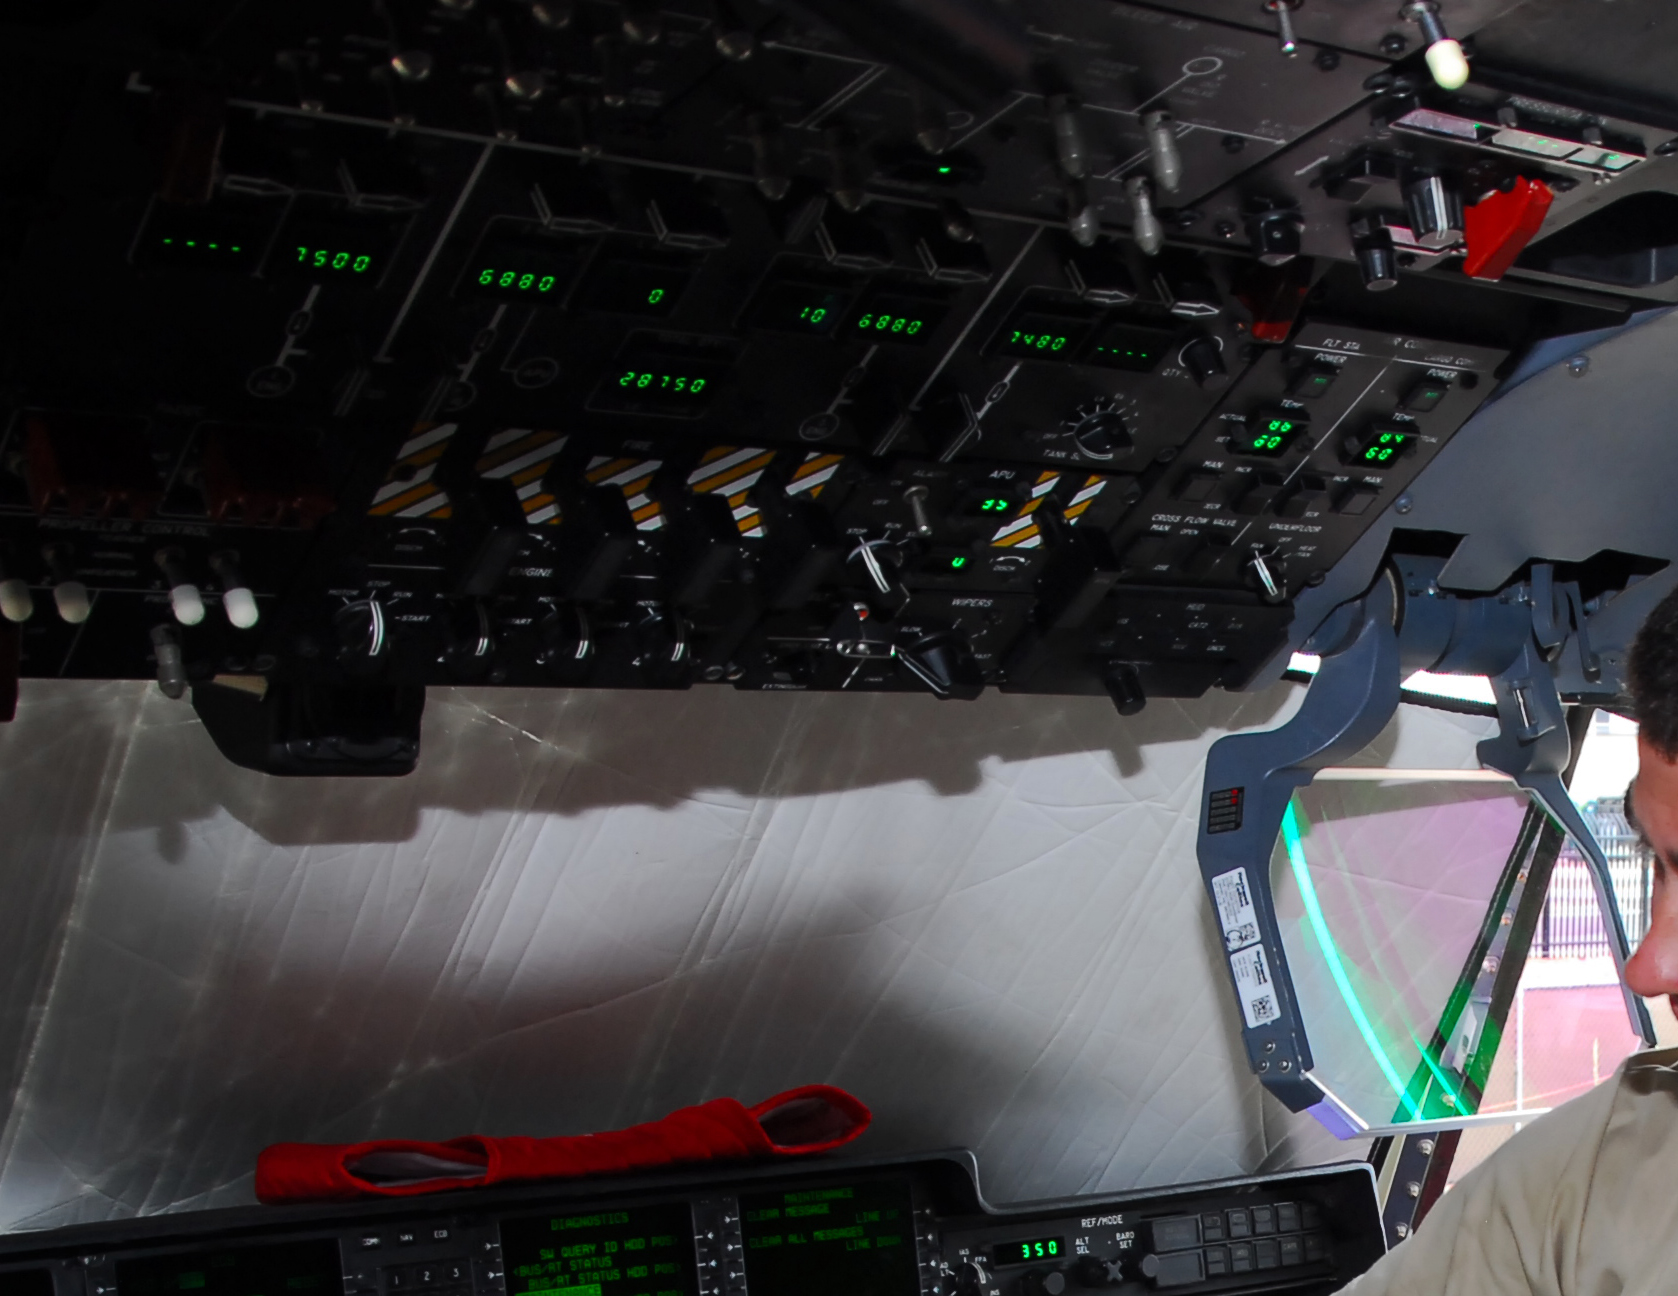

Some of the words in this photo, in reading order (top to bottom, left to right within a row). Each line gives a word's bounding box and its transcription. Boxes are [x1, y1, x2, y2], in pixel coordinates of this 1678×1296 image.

[296, 245, 371, 273] 7500
[478, 268, 557, 293] 6880
[648, 287, 665, 305] 0
[800, 306, 827, 324] 10
[858, 313, 923, 336] 6880
[1010, 331, 1067, 351] 7480
[1314, 352, 1347, 364] POWER
[1426, 368, 1458, 379] POWER
[619, 371, 706, 393] 28750
[1218, 413, 1247, 422] ACTUAL
[1253, 434, 1282, 449] 60
[1042, 449, 1068, 459] TANK
[1202, 460, 1224, 469] MAN
[988, 470, 1017, 480] APU
[1151, 513, 1182, 523] CROSS
[1183, 516, 1208, 525] FLOW
[1212, 518, 1238, 527] VALVE
[1149, 524, 1171, 532] MAN
[1268, 522, 1322, 533] UNDERFLOOR
[951, 598, 993, 607] WIPERS
[401, 614, 431, 622] START
[551, 1211, 629, 1231] DIAGNOSTICS
[1081, 1214, 1124, 1228] REF/MODE
[1075, 1237, 1090, 1245] ALT
[1115, 1231, 1135, 1241] BARO
[561, 1243, 597, 1258] QUERY
[1021, 1240, 1058, 1259] 350
[1076, 1246, 1090, 1254] SEL
[1119, 1240, 1133, 1249] SET
[569, 1255, 613, 1272] STATUS
[423, 1271, 431, 1281] 2
[578, 1268, 621, 1284] STATUS
